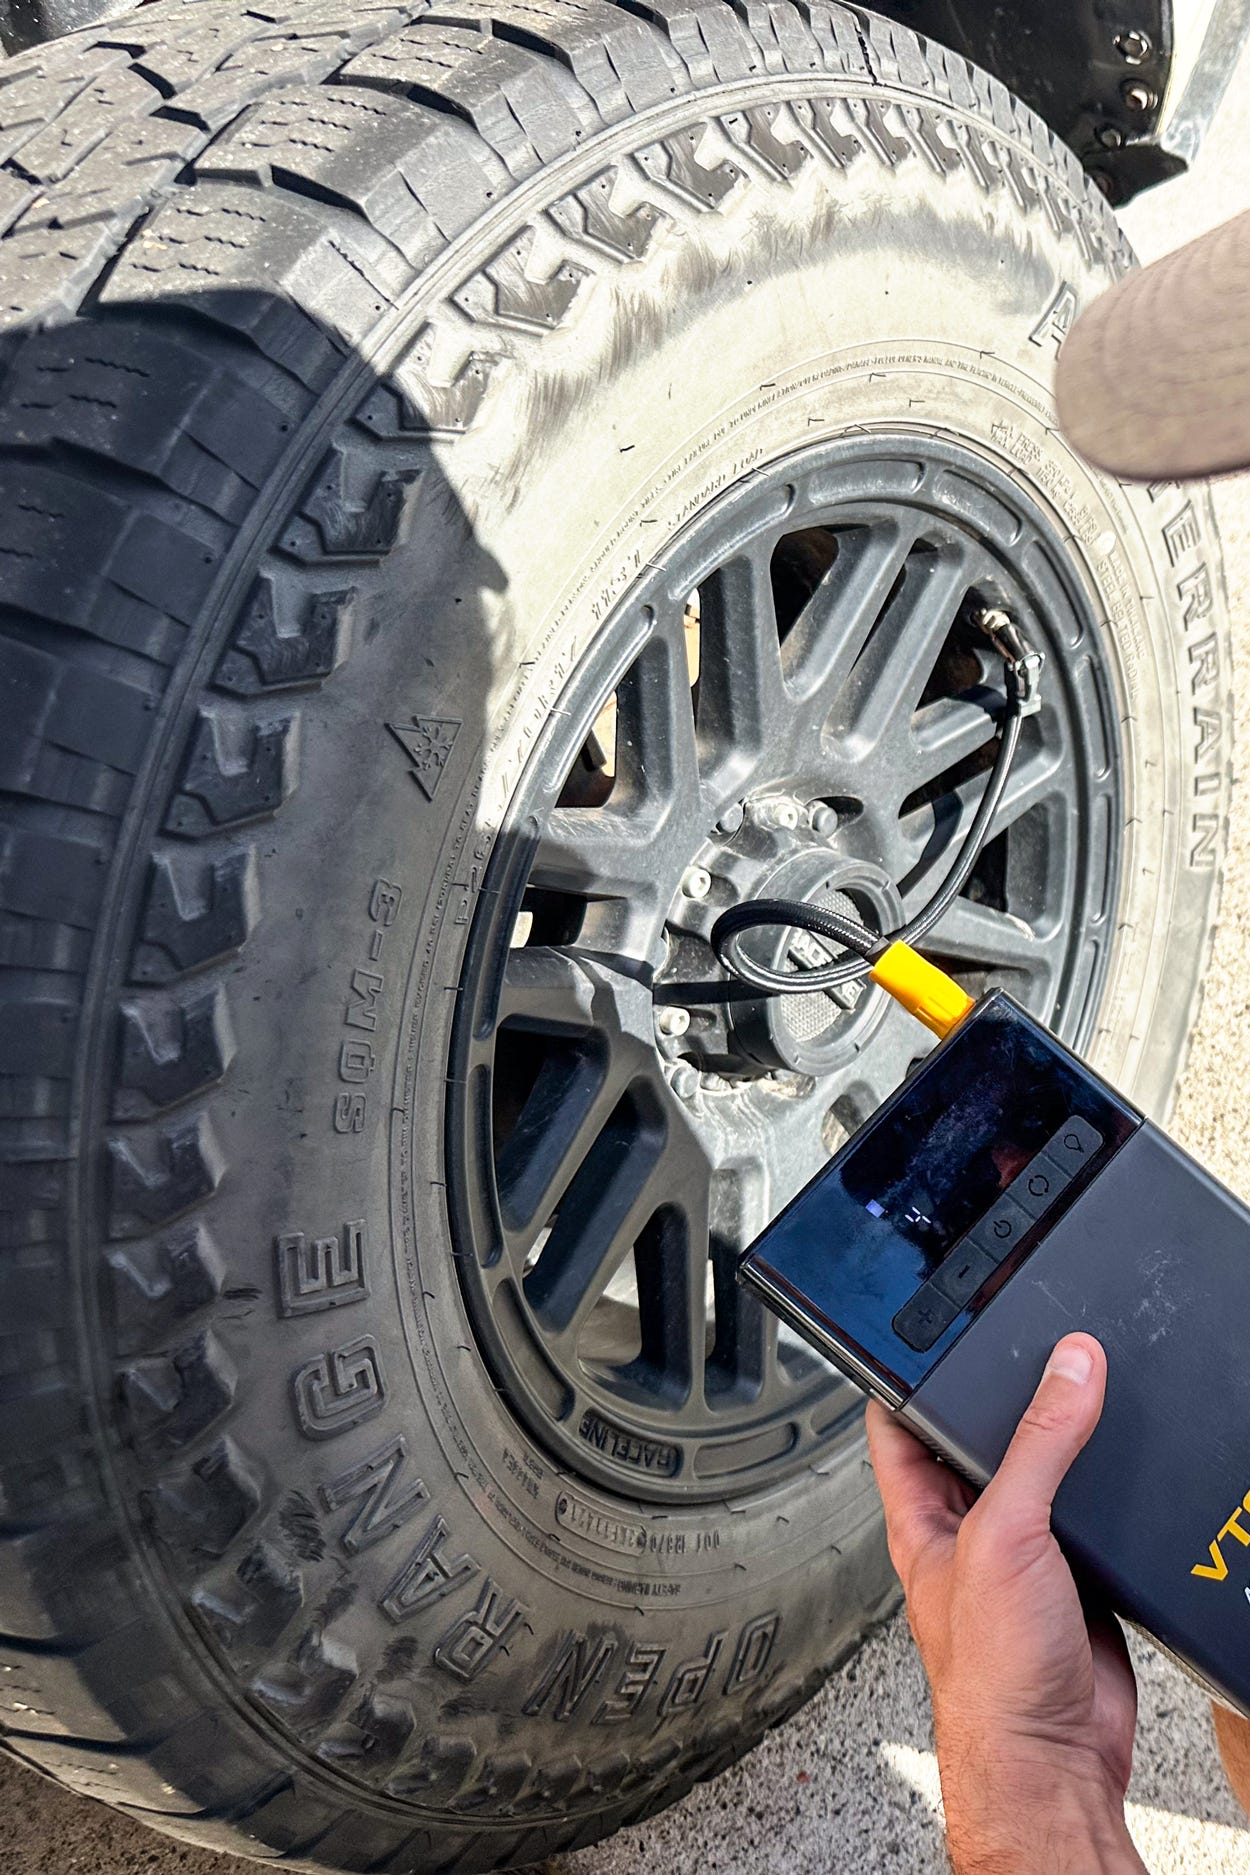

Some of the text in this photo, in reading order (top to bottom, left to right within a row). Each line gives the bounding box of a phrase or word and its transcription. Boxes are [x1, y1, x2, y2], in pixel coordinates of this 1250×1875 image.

[276, 1218, 782, 1724] OPEN RANGE
[579, 1418, 673, 1468] RACELINE
